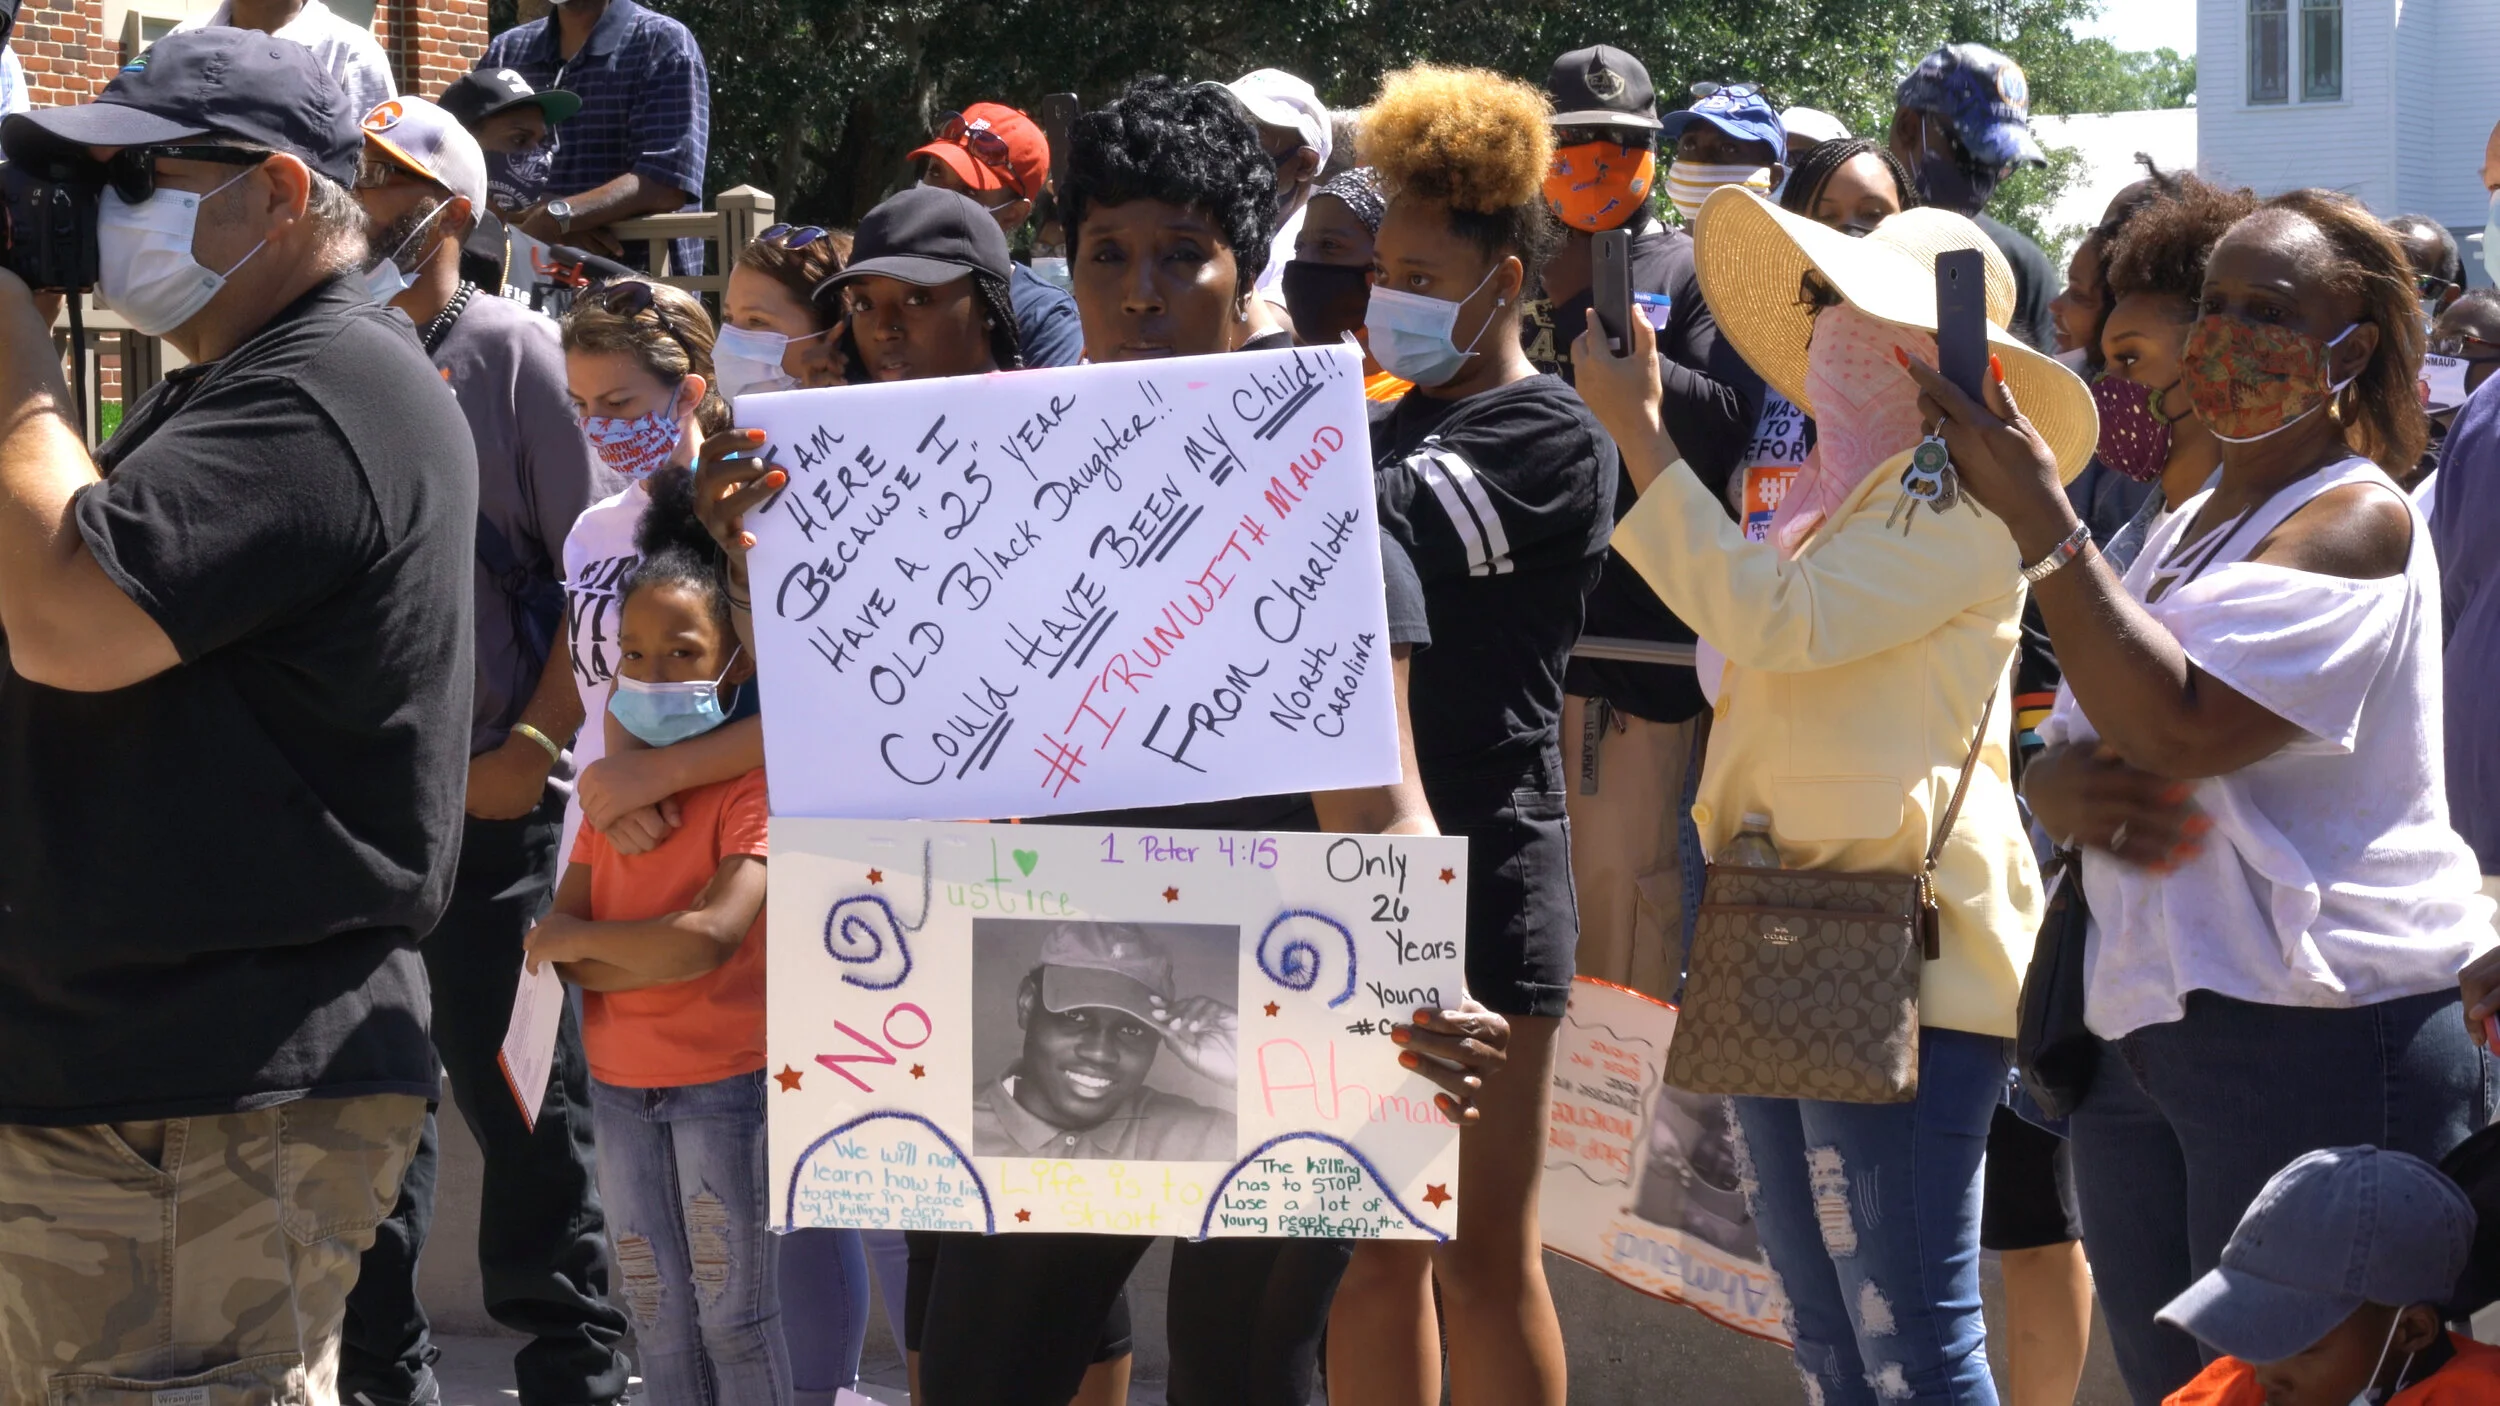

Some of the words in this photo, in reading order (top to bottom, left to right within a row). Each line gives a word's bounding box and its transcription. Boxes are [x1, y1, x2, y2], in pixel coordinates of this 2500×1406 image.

[2425, 357, 2457, 367] HMAUD
[1764, 420, 1791, 437] TO
[793, 424, 845, 473] AM
[1265, 425, 1344, 519] MAUD
[784, 444, 887, 543] HERE
[777, 464, 921, 621] BECAUSE
[916, 413, 961, 466] I
[1004, 572, 1106, 671] HAVE
[1089, 473, 1183, 570] BEEN
[1183, 413, 1247, 473] MY
[1232, 350, 1344, 424] Child!!
[808, 588, 896, 673] HAVE
[896, 554, 931, 586] A
[1000, 393, 1077, 480] YEAR
[869, 620, 946, 706] OLD
[1142, 657, 1269, 773] FROM
[1100, 832, 1124, 864] 1
[1138, 835, 1200, 863] Peter
[1218, 836, 1278, 870] 4:15
[1326, 837, 1407, 895] Only
[1371, 894, 1410, 923] 26
[1385, 928, 1457, 966] Years
[1763, 933, 1799, 942] COACH
[1366, 981, 1441, 1010] Young
[833, 1137, 870, 1160] We
[880, 1141, 917, 1167] will
[928, 1152, 959, 1170] not
[813, 1161, 874, 1185] learn
[884, 1167, 929, 1193] how
[936, 1174, 952, 1195] to
[1001, 1160, 1095, 1197] Life
[1108, 1162, 1142, 1199] is
[1161, 1166, 1204, 1206] to
[1237, 1178, 1271, 1192] has
[1282, 1177, 1301, 1192] to
[1254, 1158, 1295, 1175] The
[1306, 1156, 1361, 1185] killing
[799, 1201, 822, 1218] by
[839, 1202, 890, 1224] killing
[901, 1204, 945, 1220] each
[802, 1185, 876, 1211] together
[881, 1188, 905, 1204] in
[915, 1193, 965, 1209] peace
[1224, 1194, 1267, 1210] Lose
[1284, 1200, 1299, 1210] a
[1320, 1195, 1351, 1212] lot
[1362, 1198, 1383, 1213] of
[899, 1214, 974, 1231] children
[1279, 1213, 1331, 1230] people
[1341, 1217, 1369, 1231] on
[1377, 1215, 1404, 1230] the
[157, 1393, 204, 1405] Wrangler
